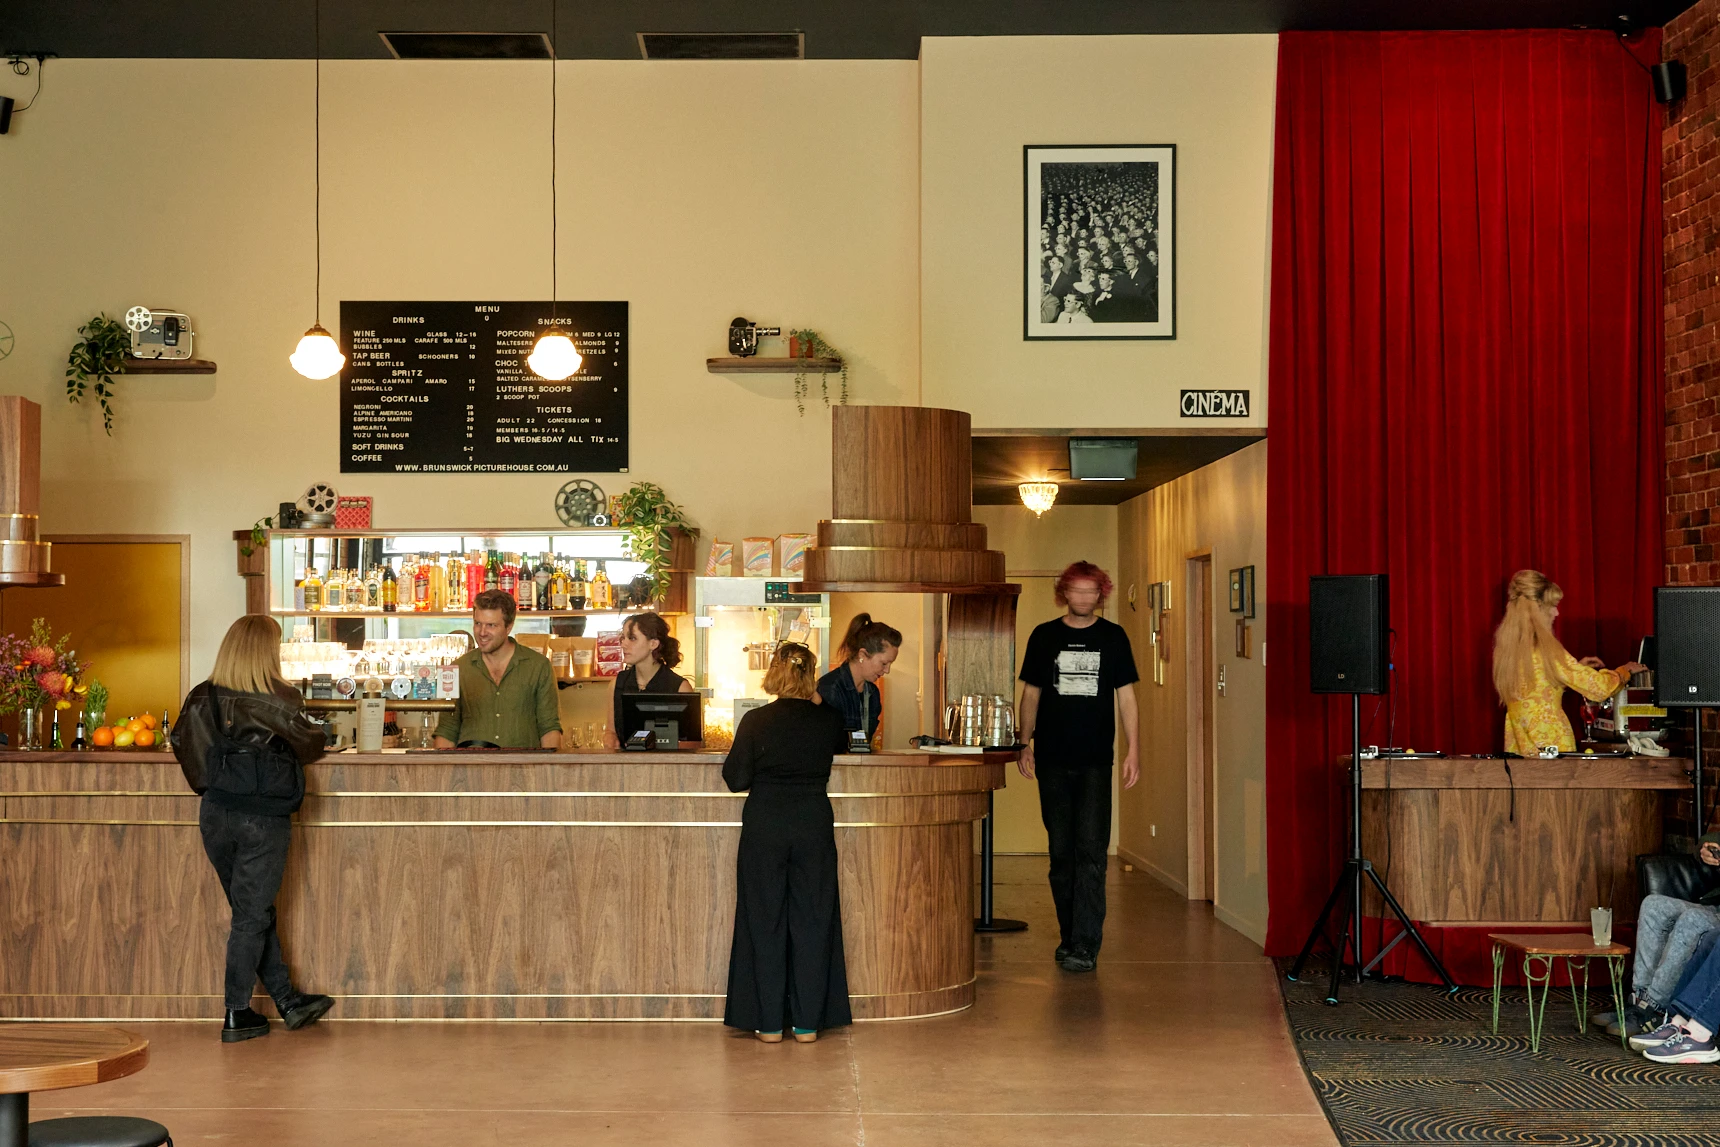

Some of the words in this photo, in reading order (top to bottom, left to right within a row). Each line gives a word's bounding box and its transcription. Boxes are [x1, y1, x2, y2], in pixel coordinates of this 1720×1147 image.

[497, 330, 535, 338] POPCORN
[1181, 391, 1248, 415] CINÉMA
[1688, 685, 1698, 694] LD
